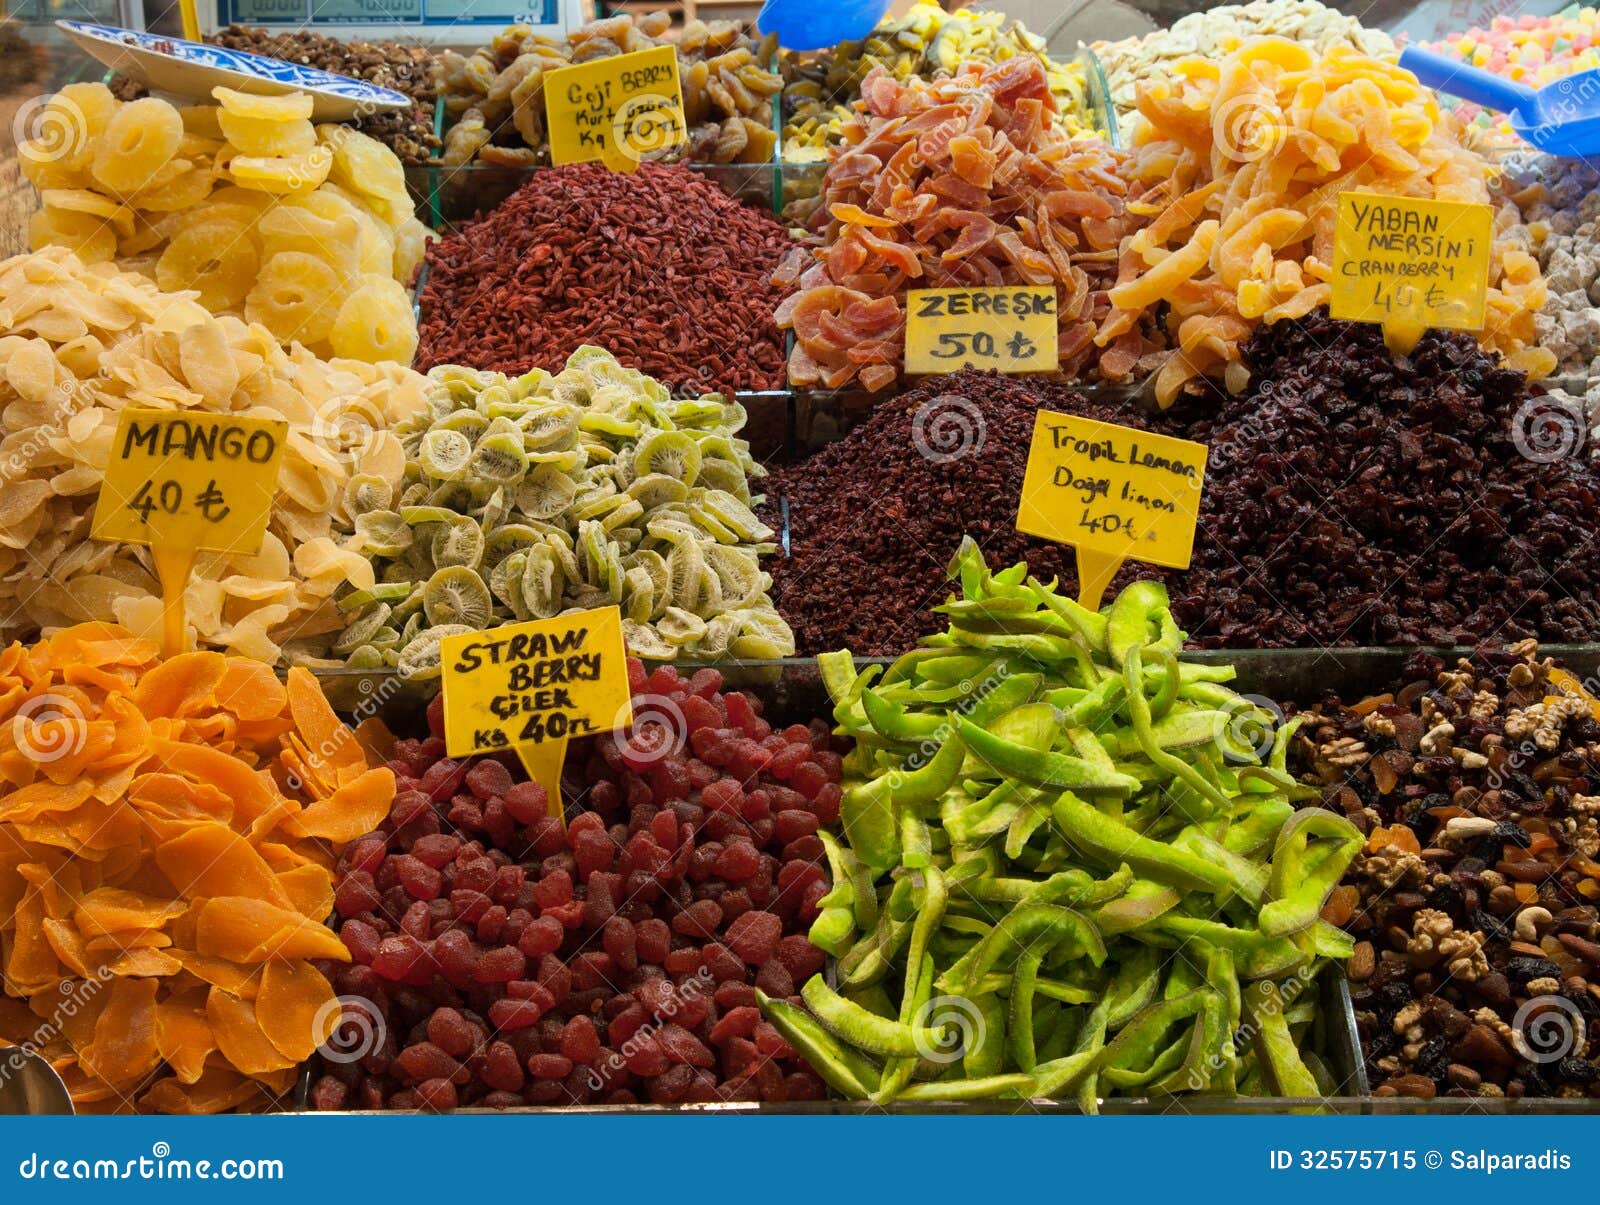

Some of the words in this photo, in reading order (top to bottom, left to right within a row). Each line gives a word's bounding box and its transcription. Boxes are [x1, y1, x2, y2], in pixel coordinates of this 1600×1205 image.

[620, 64, 674, 93] BERRY
[575, 107, 616, 126] Kurt
[1351, 201, 1439, 233] YABAN
[1341, 260, 1455, 281] CRANBERRY
[916, 292, 1057, 321] ZEREŞK
[121, 419, 275, 464] MANGO
[1047, 425, 1125, 463] Tropik
[127, 479, 183, 524] 40
[454, 628, 589, 673] STRAW
[507, 652, 602, 692] BERRY
